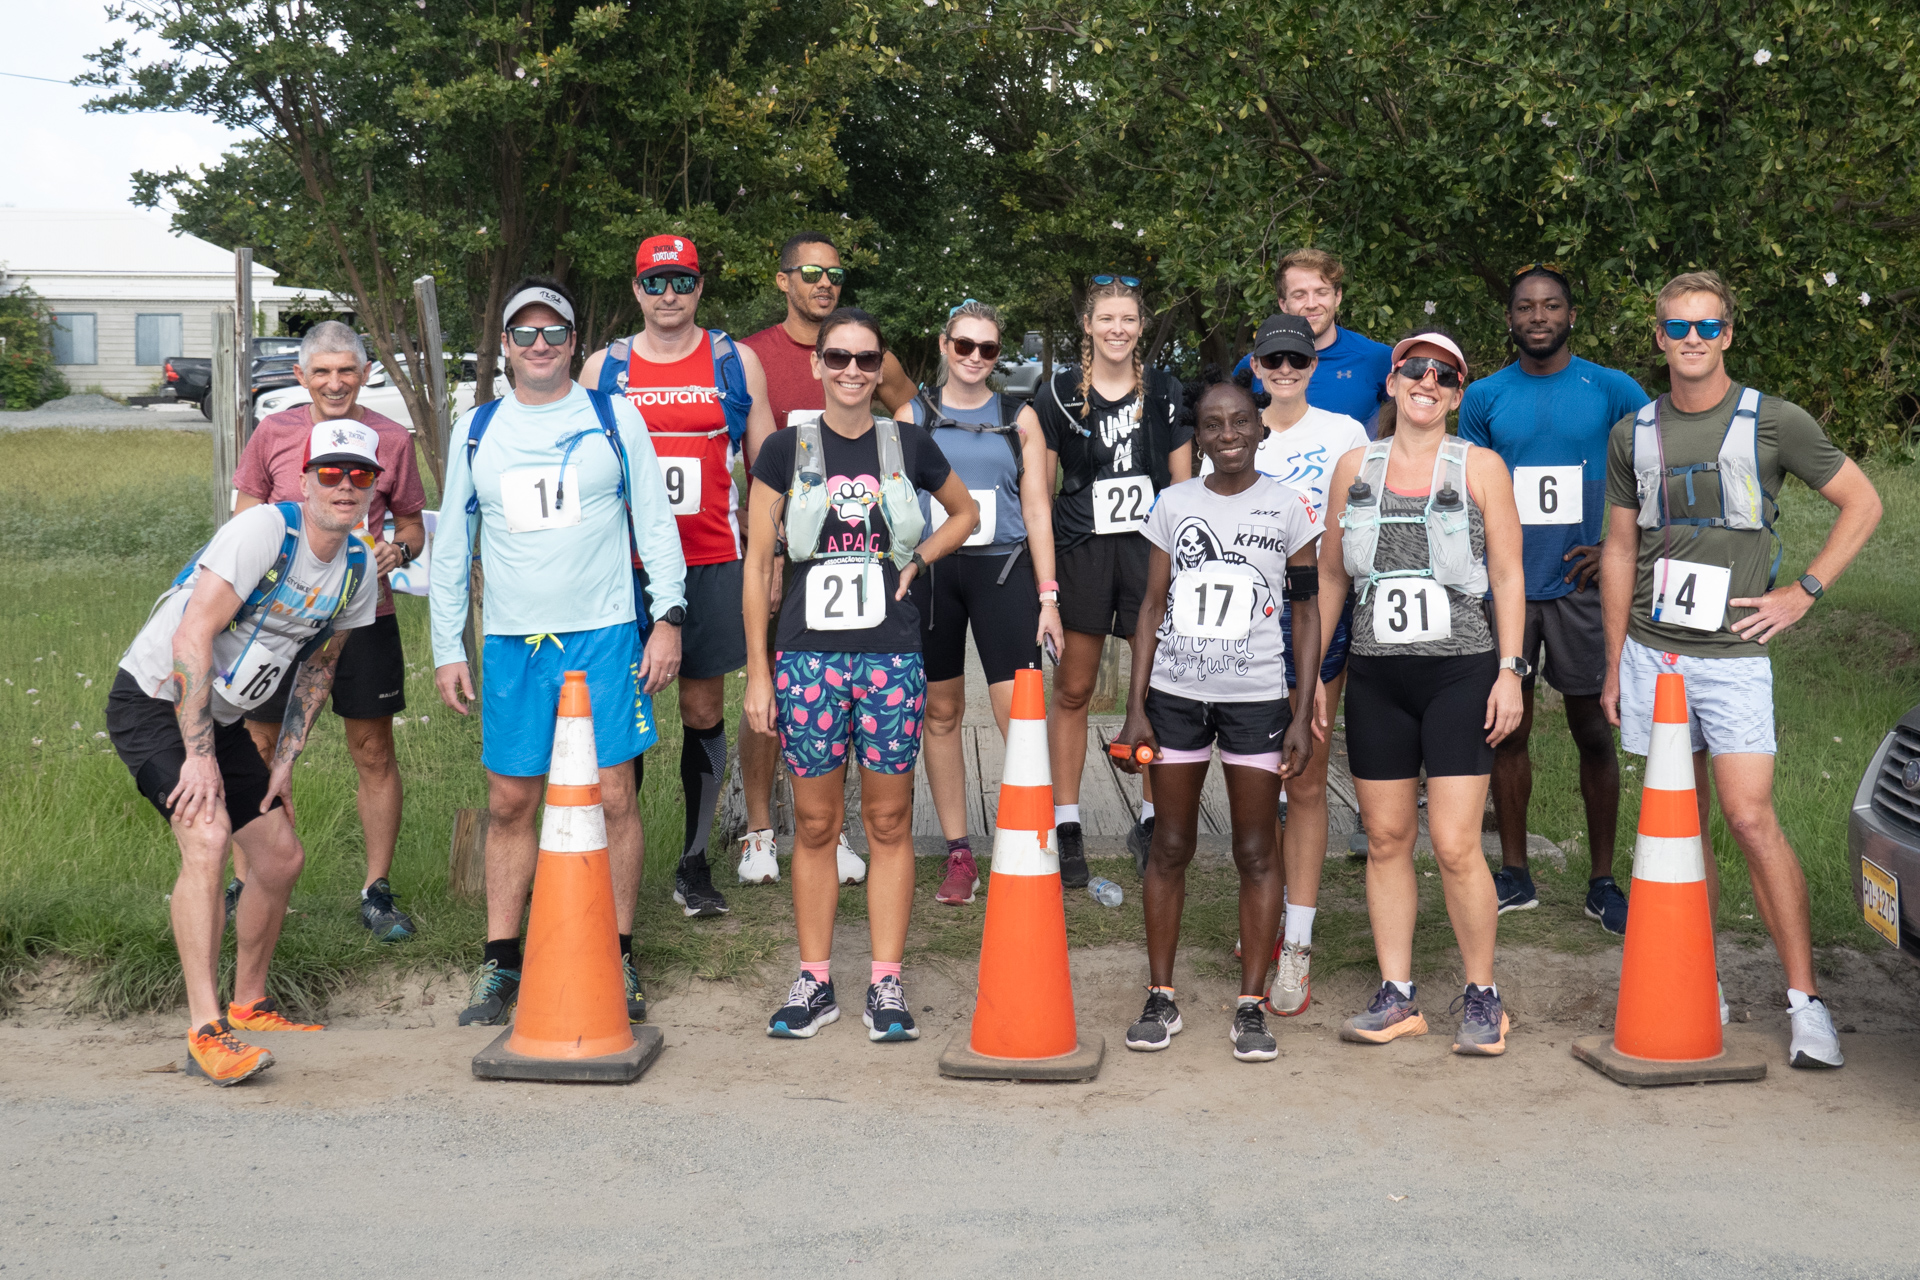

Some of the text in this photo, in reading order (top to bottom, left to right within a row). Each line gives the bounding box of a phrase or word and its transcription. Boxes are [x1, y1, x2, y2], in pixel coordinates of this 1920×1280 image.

[652, 251, 679, 263] TORTURE
[627, 391, 714, 407] mourant
[534, 478, 549, 518] 1
[665, 466, 685, 505] 9
[1107, 485, 1144, 523] 22
[1539, 475, 1558, 514] 6
[1745, 474, 1757, 523] NATHAN
[1233, 533, 1287, 553] KPMG
[823, 574, 865, 618] 21
[1194, 582, 1234, 627] 17
[1387, 588, 1429, 633] 31
[1675, 573, 1697, 615] 4
[239, 662, 281, 700] 16
[1864, 875, 1896, 926] PD-1275
